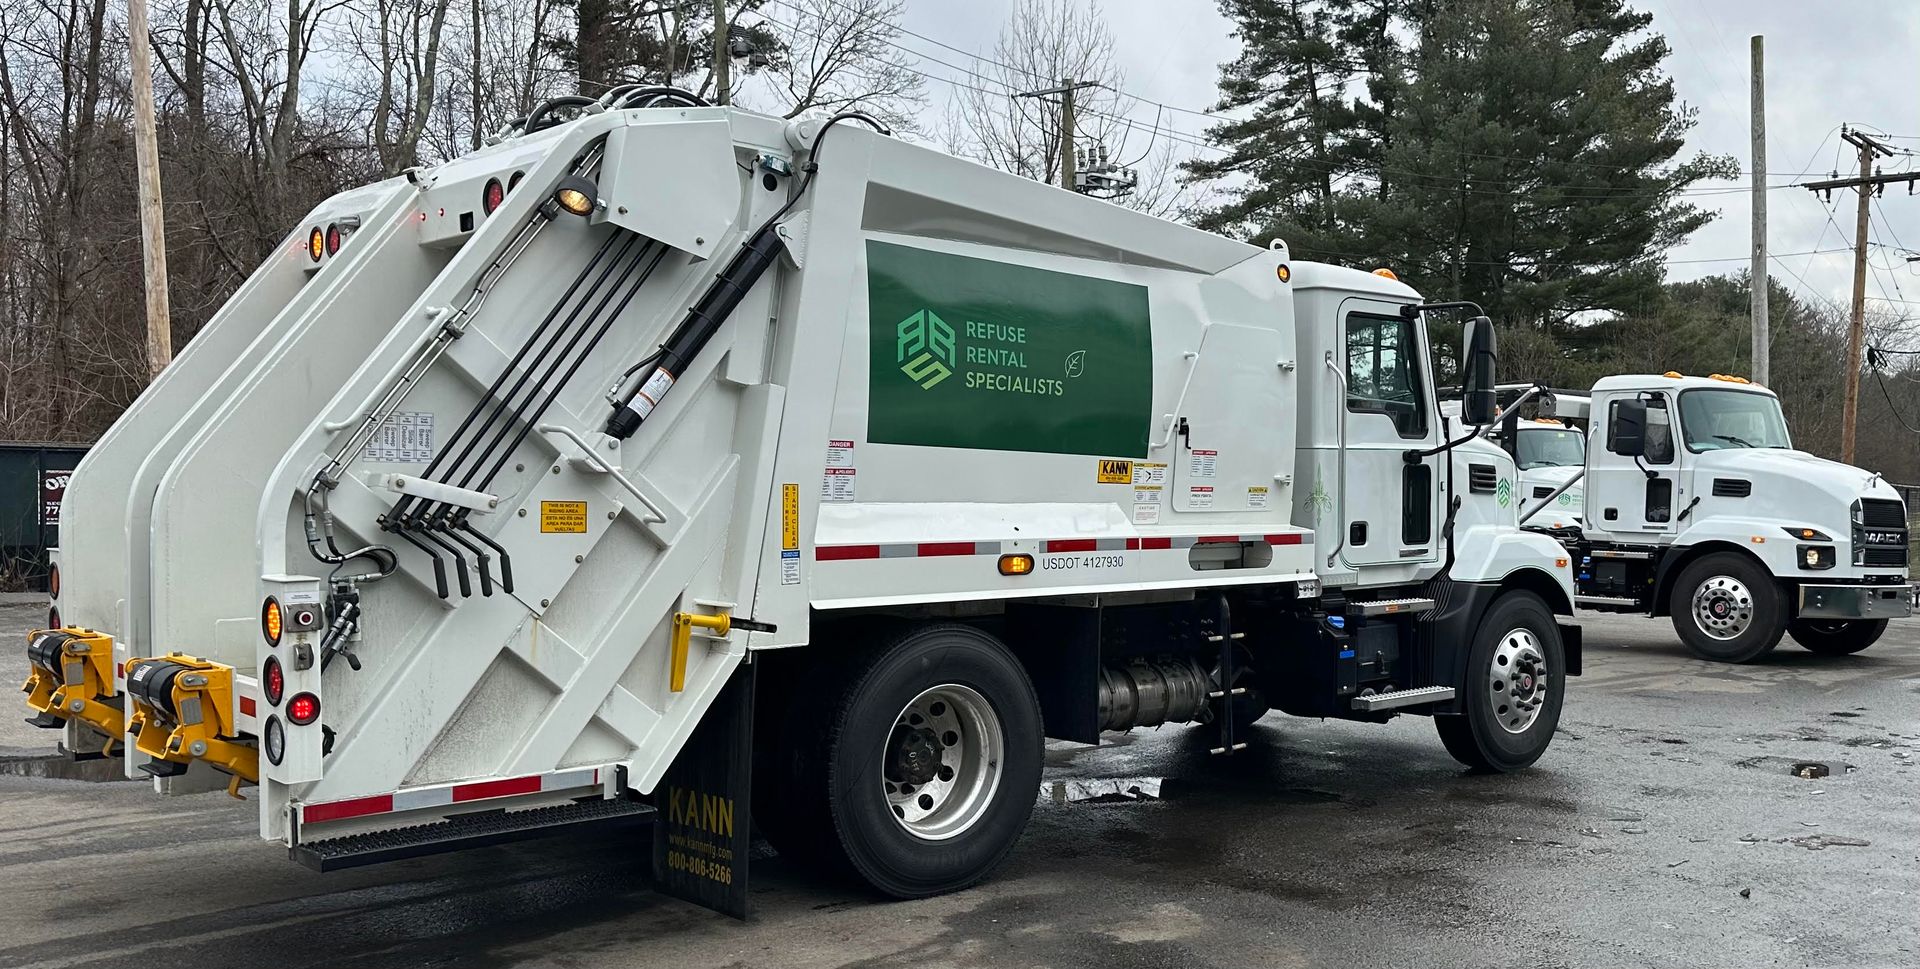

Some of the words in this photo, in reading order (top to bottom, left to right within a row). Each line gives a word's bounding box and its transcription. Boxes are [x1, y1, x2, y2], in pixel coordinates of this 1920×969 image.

[966, 321, 1026, 343] REFUSE
[966, 346, 1027, 368] RENTAL
[965, 371, 1063, 396] SPECIALISTS
[1102, 461, 1129, 475] KANN
[1865, 532, 1902, 543] MACK
[1042, 557, 1080, 570] USDOT
[1083, 555, 1124, 568] 4127930
[669, 785, 734, 838] KANN
[669, 832, 733, 860] www.kannmfg.com
[668, 850, 732, 885] 800-806-5266
